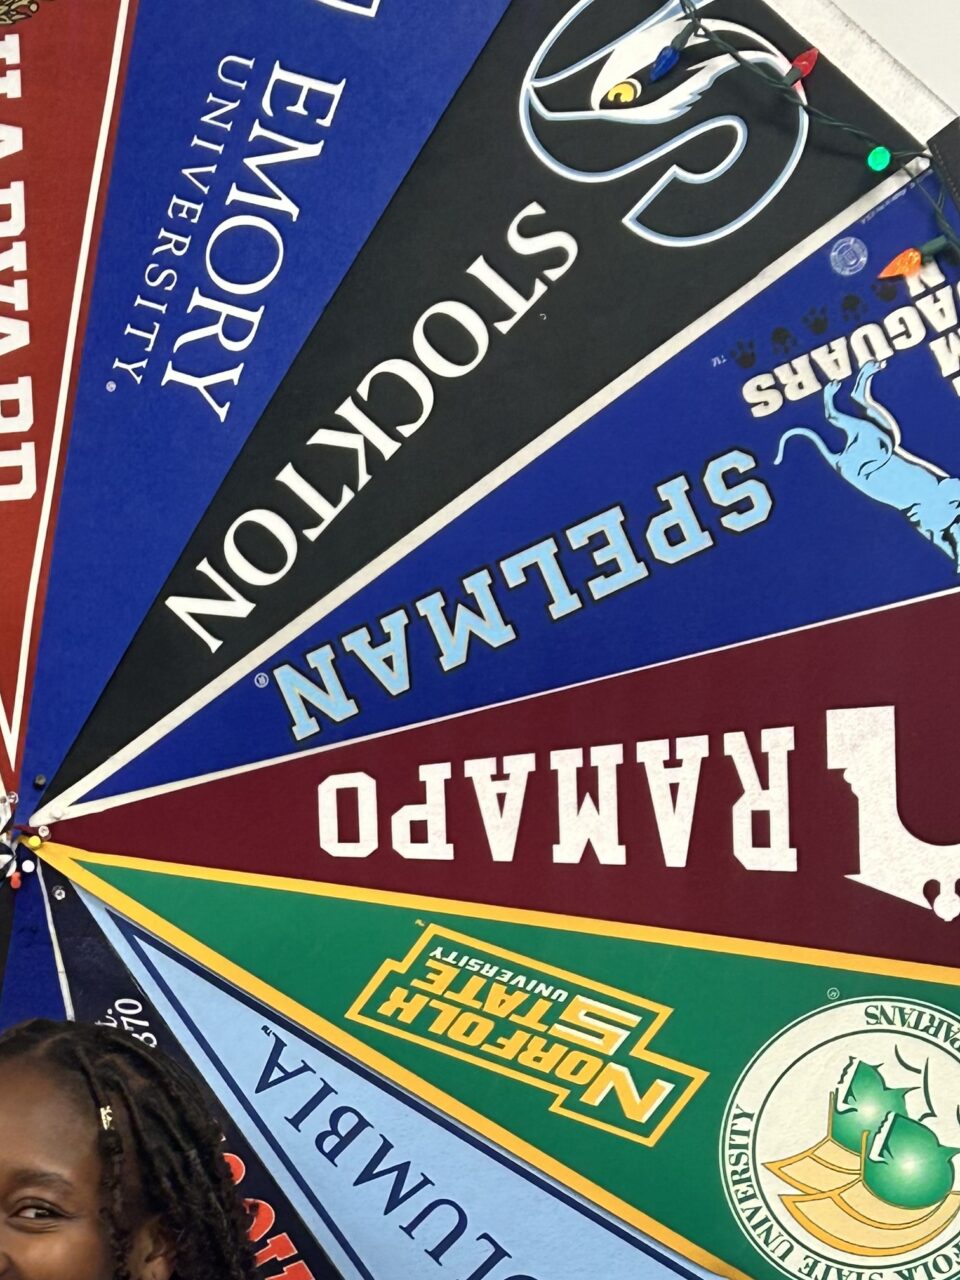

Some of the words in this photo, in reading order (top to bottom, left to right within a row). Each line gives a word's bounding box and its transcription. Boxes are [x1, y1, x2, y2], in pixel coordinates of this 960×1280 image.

[113, 54, 255, 385] UNIVERSITY
[161, 60, 346, 423] EMORY
[166, 202, 579, 653] STOCKTON
[742, 284, 960, 418] AGUARS
[271, 448, 774, 742] SPELMAN
[317, 726, 798, 872] RAMAPO
[410, 958, 643, 1056] STATE
[429, 946, 569, 1002] UNIVERSITY
[377, 986, 676, 1124] NORFOLK
[728, 1104, 795, 1264] UNIVERSITY
